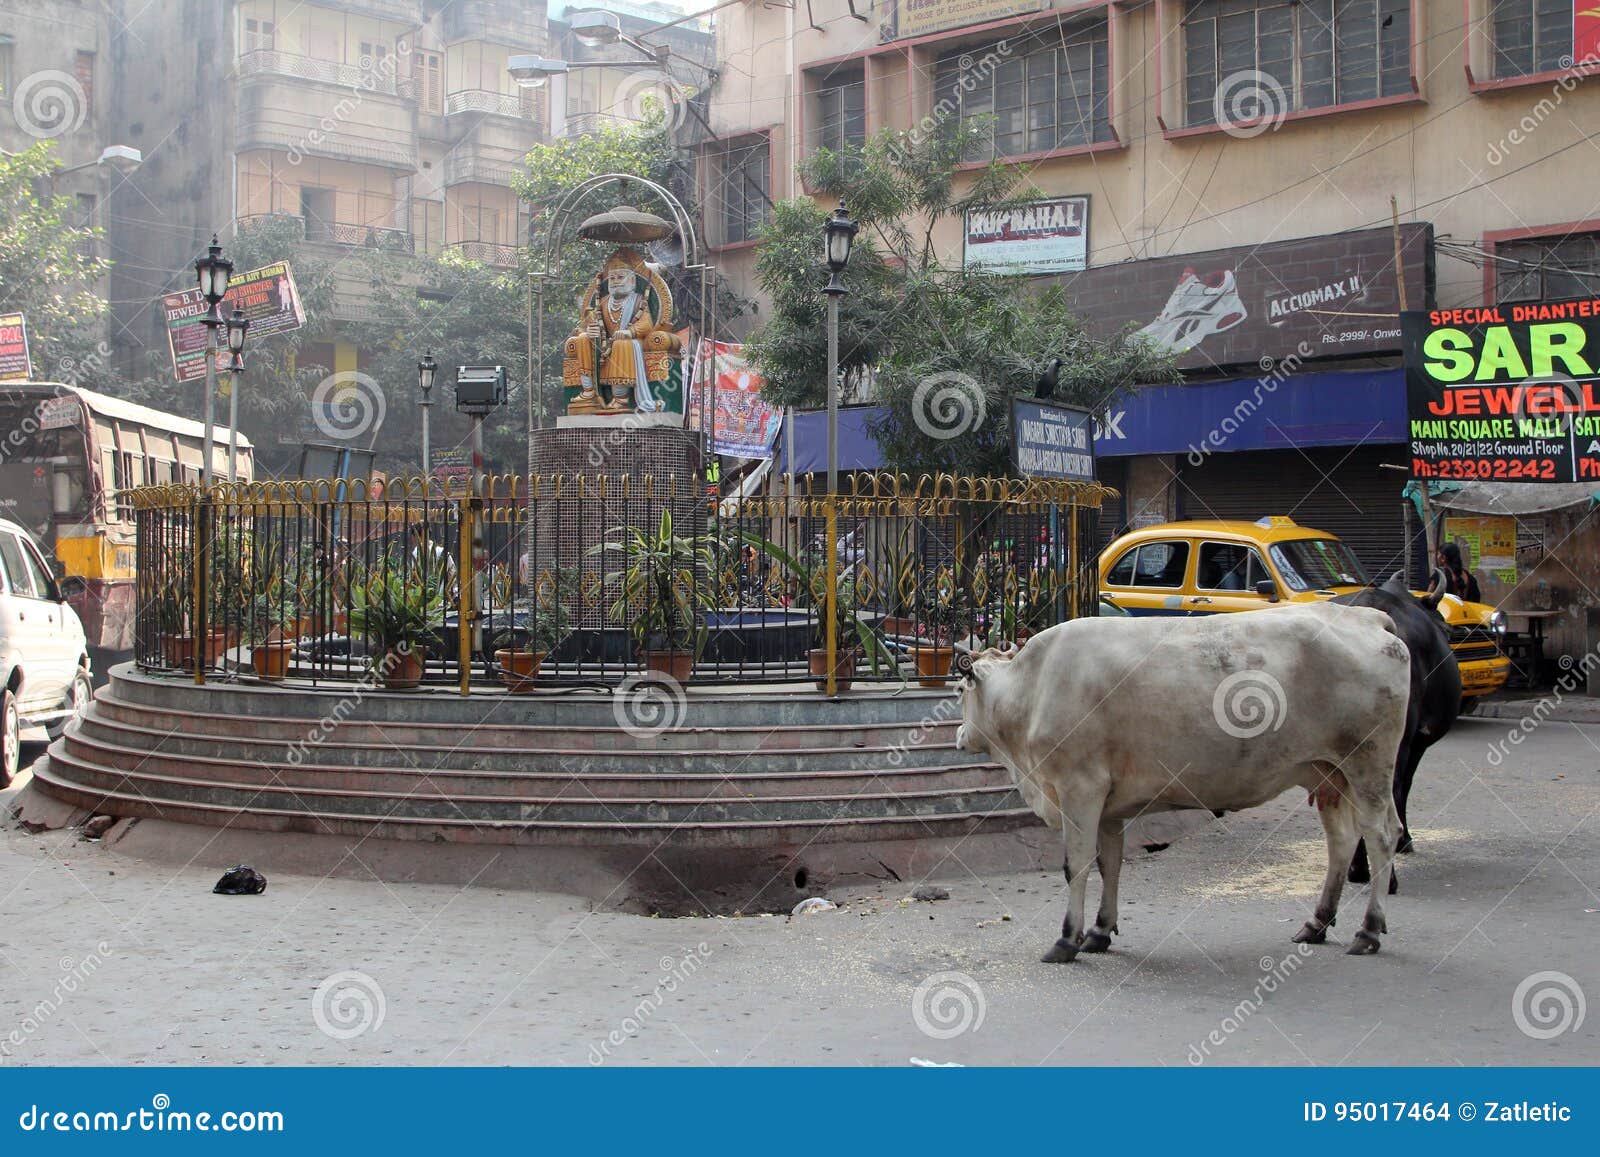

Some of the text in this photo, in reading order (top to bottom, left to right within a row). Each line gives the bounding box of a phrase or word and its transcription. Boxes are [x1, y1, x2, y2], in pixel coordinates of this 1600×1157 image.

[167, 302, 209, 321] JEWELL
[1429, 308, 1505, 326] SPECIAL
[1340, 329, 1371, 343] 2999/-
[1423, 322, 1600, 382] SAR
[1411, 417, 1566, 442] MANI SQUARE MALL
[1451, 440, 1494, 458] 20/21/22
[1494, 440, 1533, 456] Ground
[1535, 440, 1564, 456] Floor
